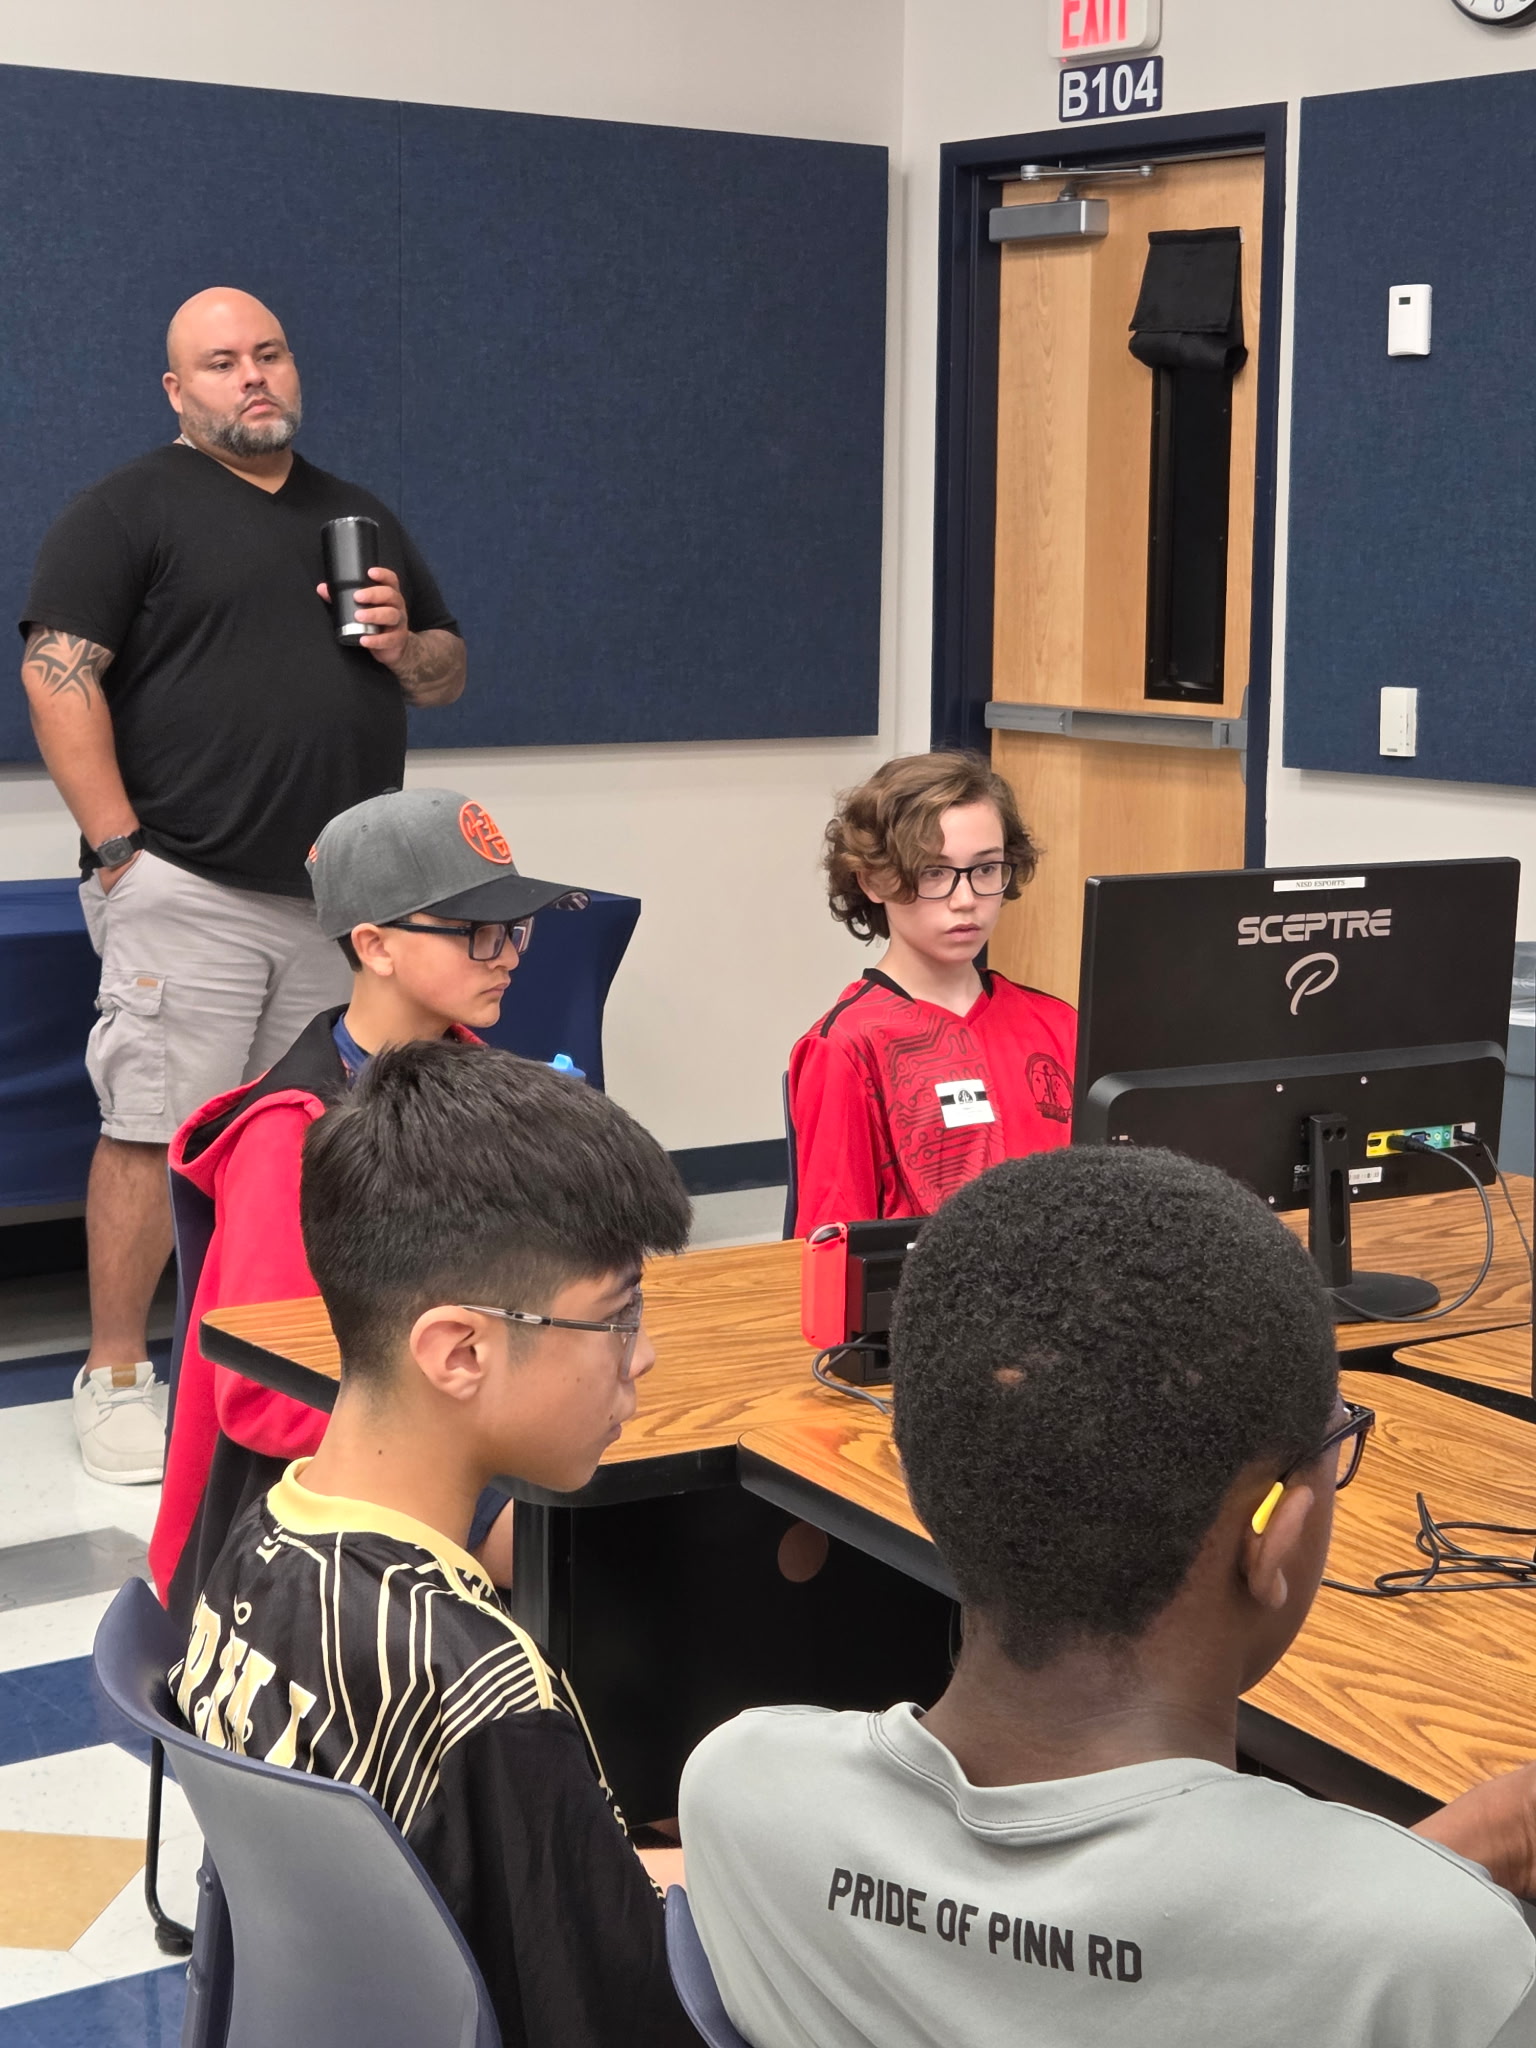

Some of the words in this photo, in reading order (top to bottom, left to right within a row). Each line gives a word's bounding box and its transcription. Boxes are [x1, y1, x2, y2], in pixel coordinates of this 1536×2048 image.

[1062, 60, 1158, 118] B104
[1314, 879, 1346, 887] ESPORTS
[1237, 908, 1392, 946] SCEPTRE
[827, 1867, 928, 1934] PRIDE
[936, 1898, 979, 1946] OF
[988, 1911, 1075, 1972] PINN
[1088, 1933, 1143, 1983] RD
